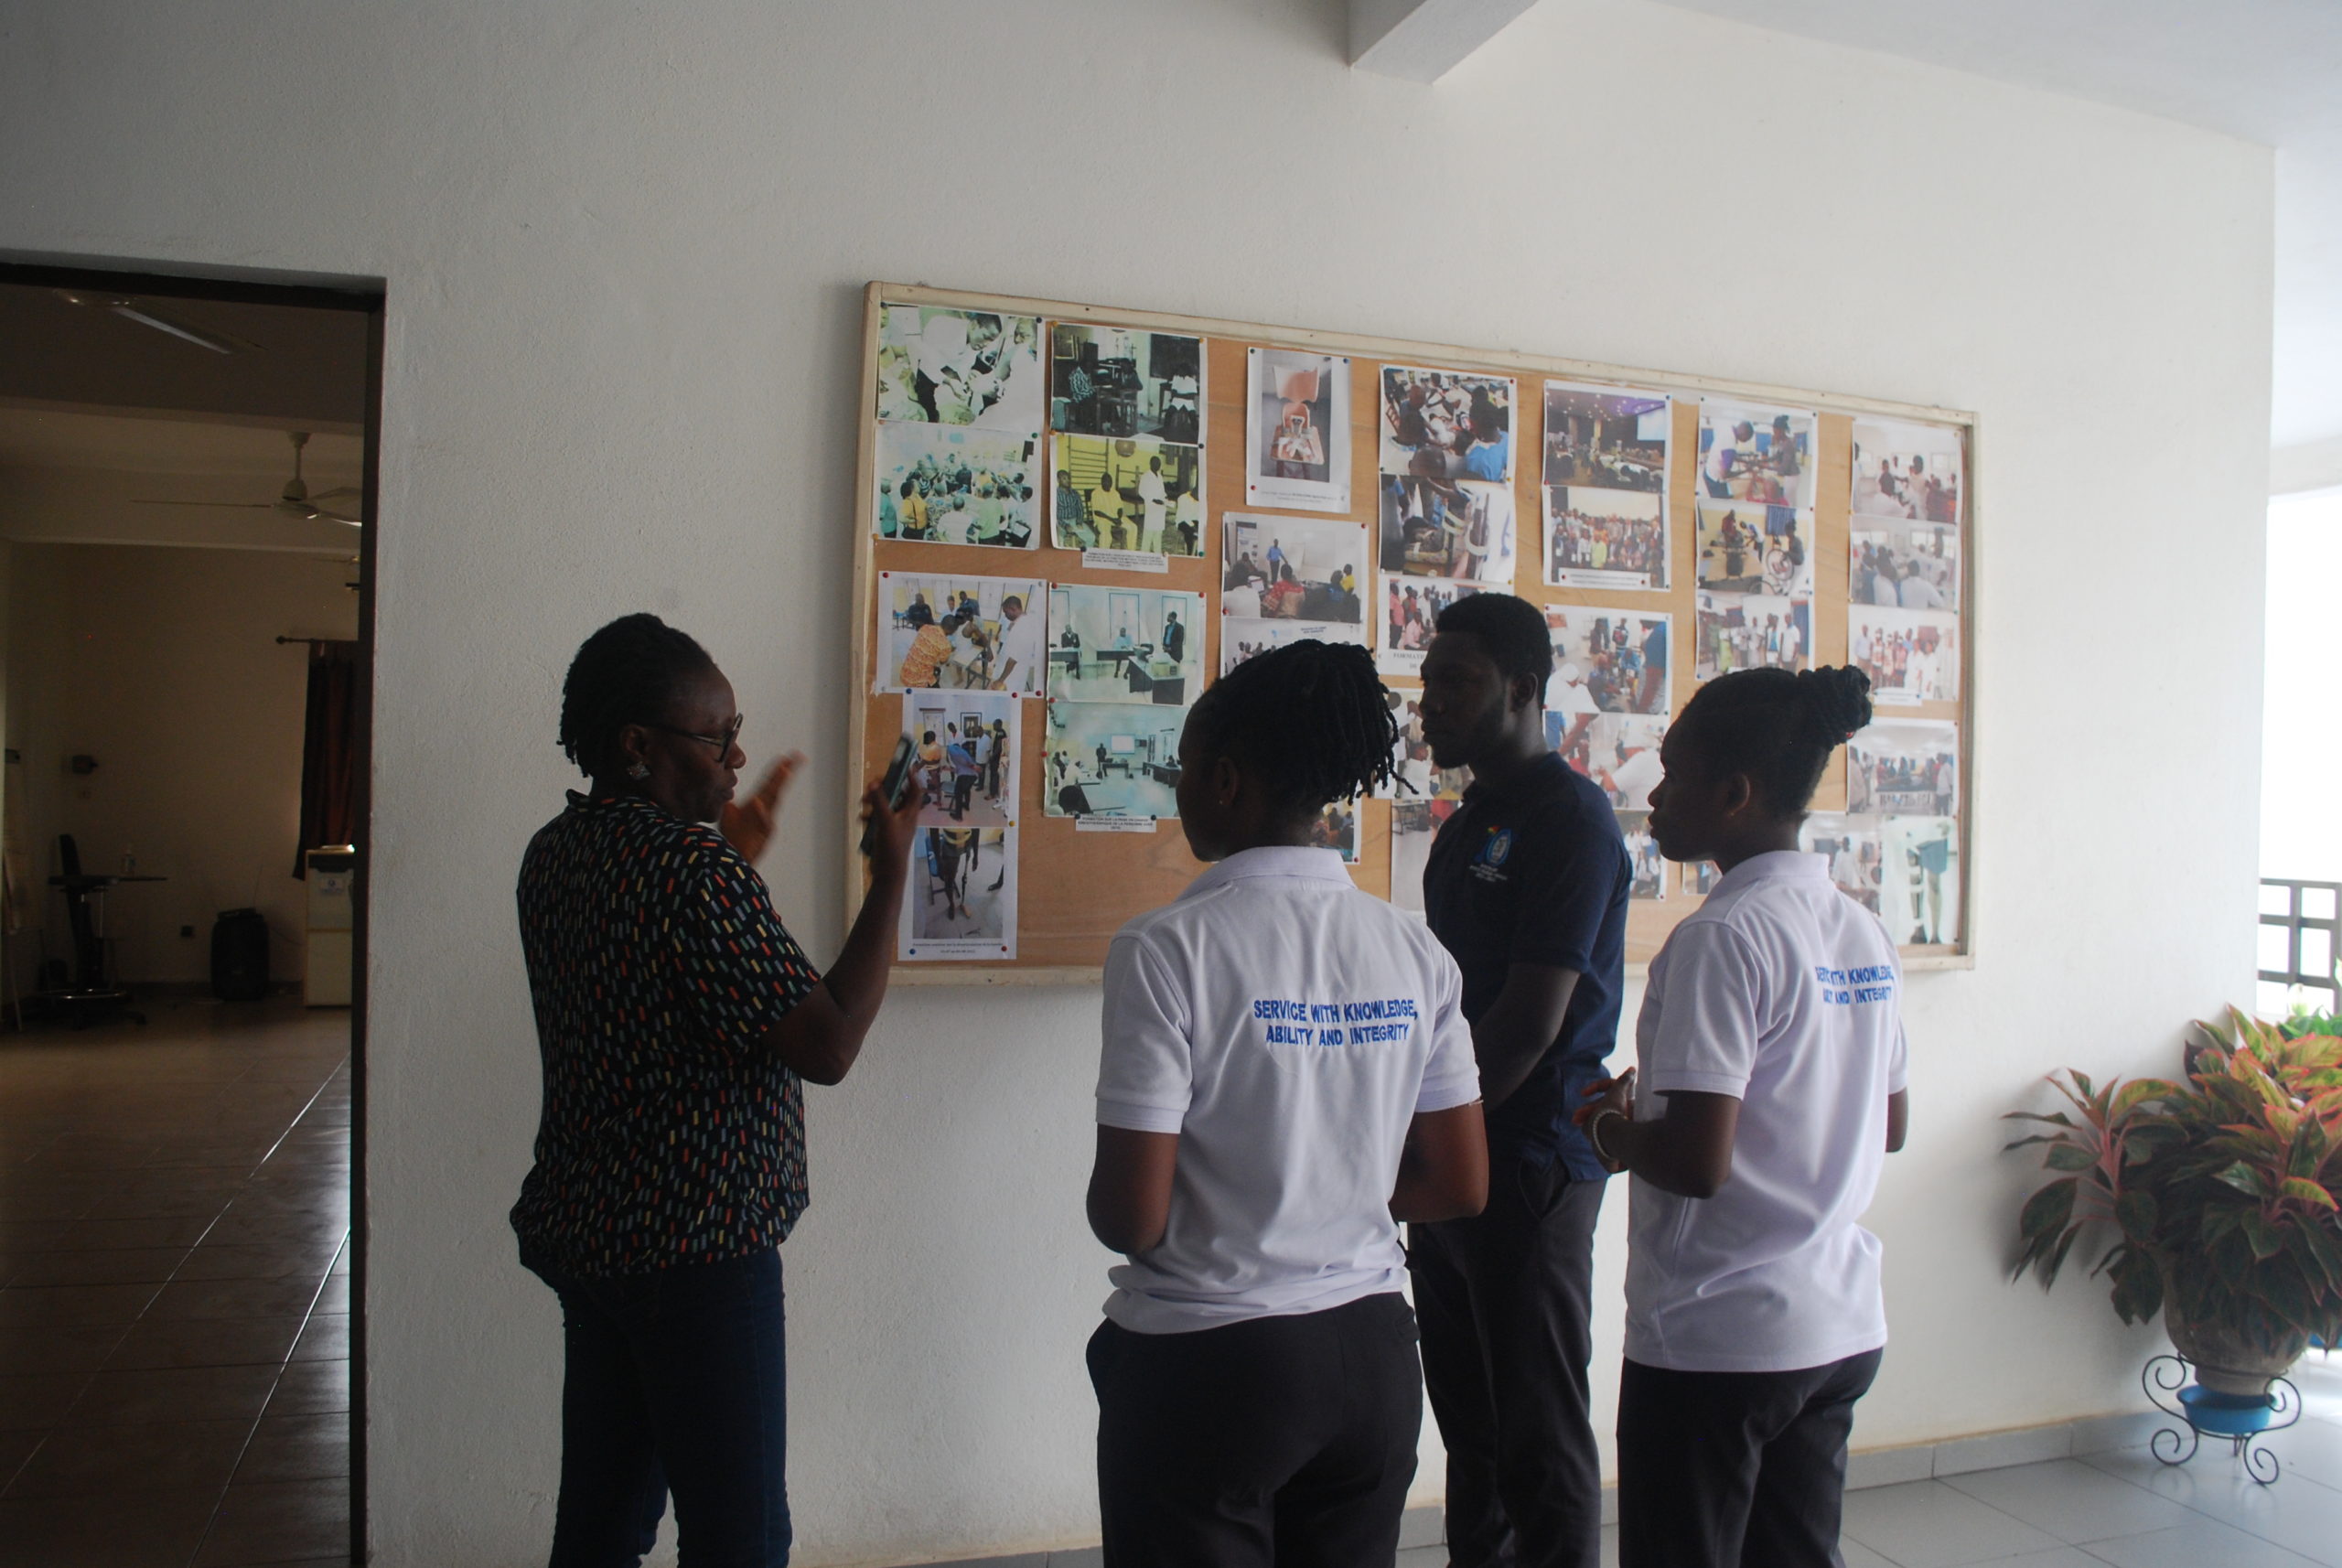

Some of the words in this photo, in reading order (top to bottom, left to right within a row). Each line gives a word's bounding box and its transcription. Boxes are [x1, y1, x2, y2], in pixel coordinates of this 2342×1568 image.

[1831, 970, 1846, 985] ITH
[1847, 965, 1895, 984] KNOWLE,
[1253, 1000, 1306, 1022] SERVICE
[1310, 1004, 1339, 1023] WITH
[1343, 999, 1418, 1023] KNOWLEDGE,
[1265, 1025, 1313, 1046] ABILITY
[1318, 1029, 1343, 1046] AND
[1349, 1024, 1409, 1046] INTEGRITY
